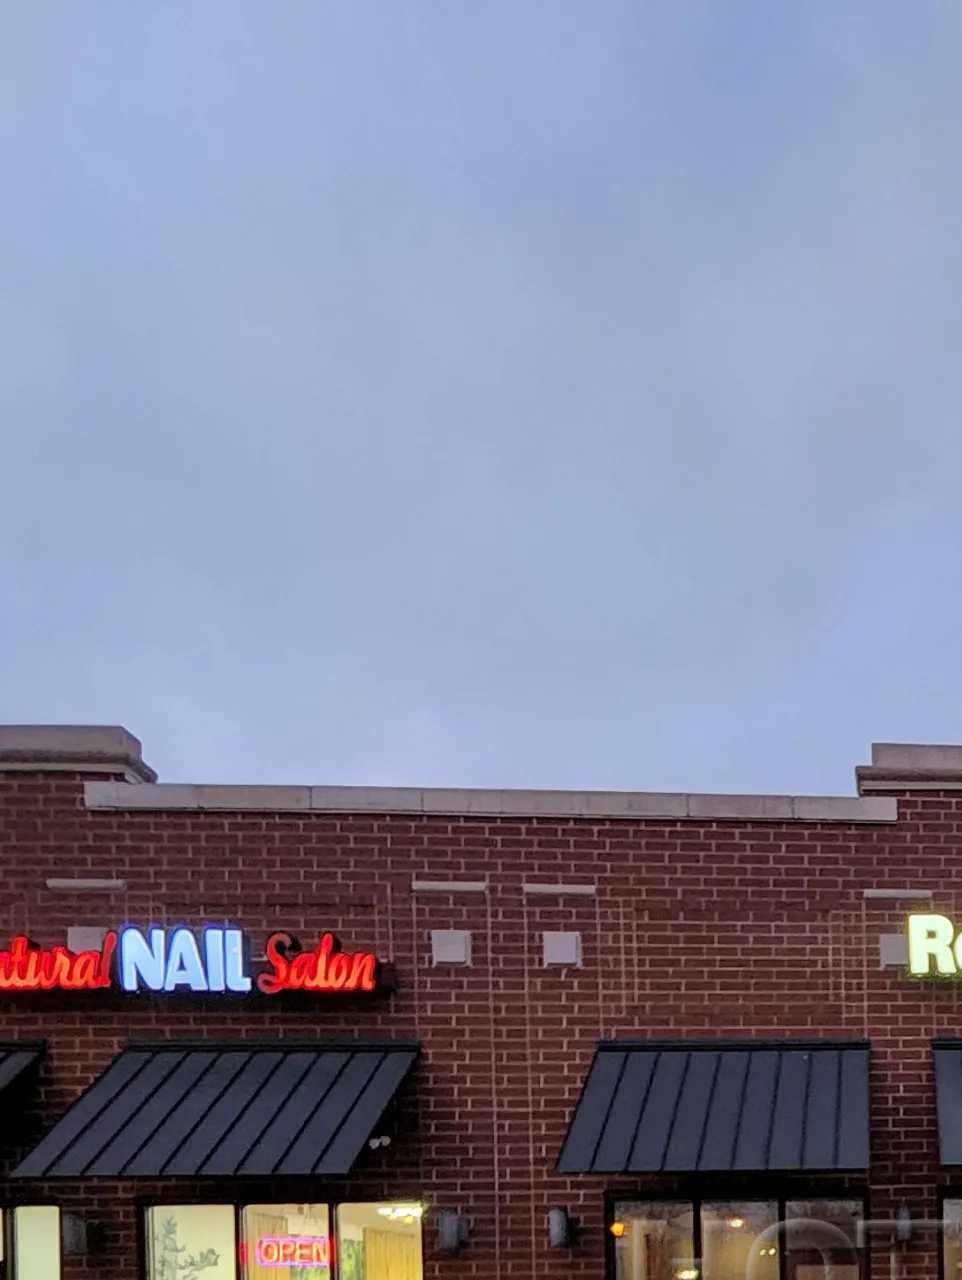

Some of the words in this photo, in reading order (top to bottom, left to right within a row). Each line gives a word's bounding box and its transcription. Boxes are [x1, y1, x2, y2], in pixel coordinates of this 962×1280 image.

[119, 926, 253, 992] NAIL
[257, 931, 375, 993] Salon
[261, 1240, 329, 1263] OPEN
